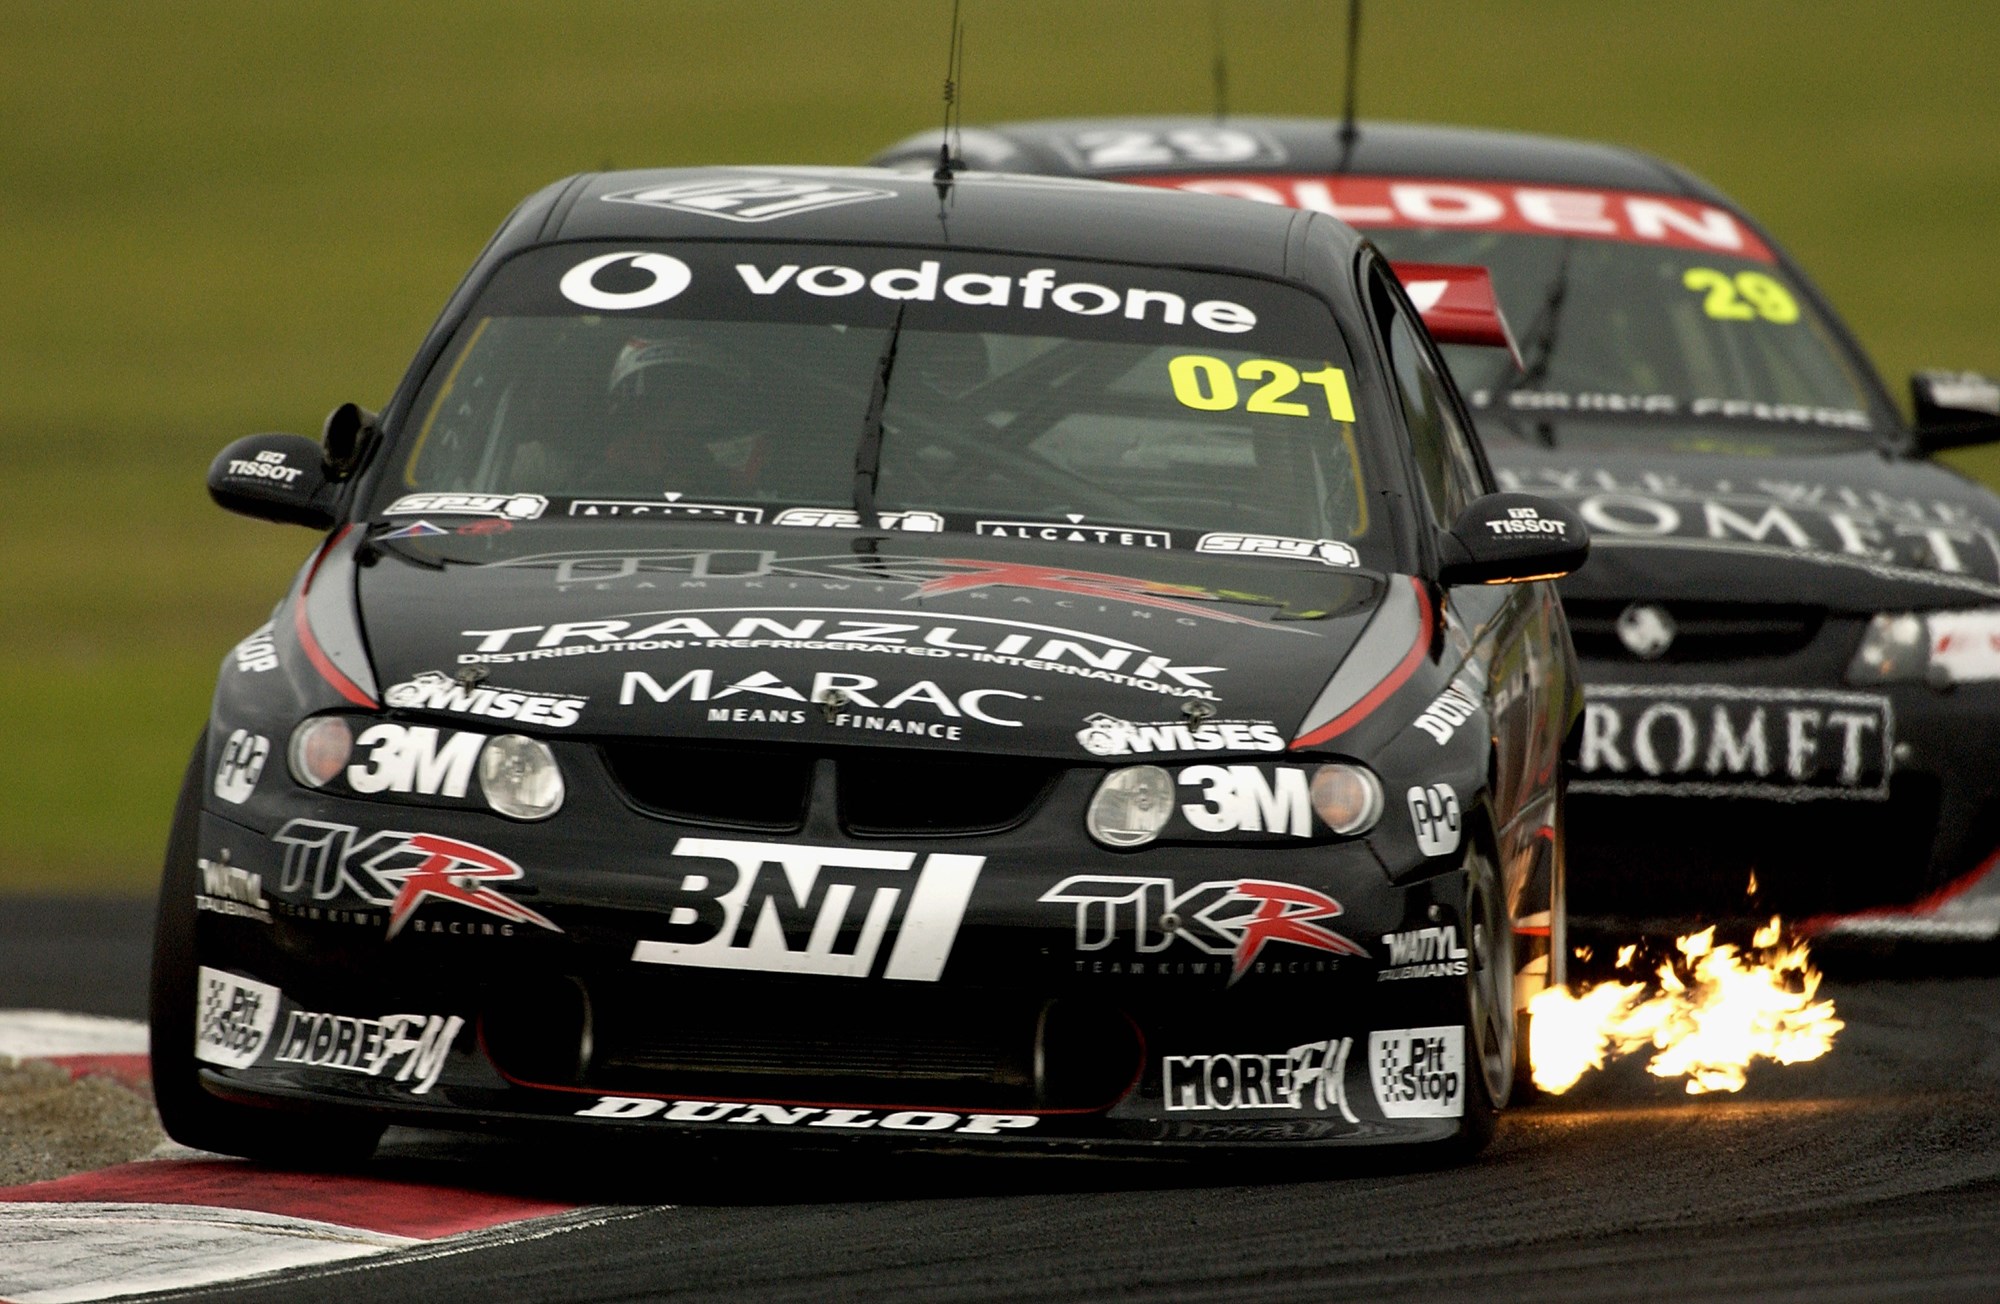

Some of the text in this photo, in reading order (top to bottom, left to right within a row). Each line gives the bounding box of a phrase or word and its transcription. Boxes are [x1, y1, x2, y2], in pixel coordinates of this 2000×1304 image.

[735, 261, 1258, 333] vodafone
[1683, 267, 1800, 325] 29
[1168, 355, 1357, 423] 021
[228, 459, 303, 483] TISSOT
[388, 494, 515, 516] SPY
[1485, 518, 1567, 535] TISSOT
[991, 526, 1160, 549] ALCATEL
[1201, 534, 1318, 558] SPY
[555, 581, 1197, 627] TEAM KIWI RACING
[456, 638, 1224, 701] DISTRIBUTION REFRIGERATED INTERNATIONAL
[461, 617, 1228, 688] TRANZLINK
[421, 680, 587, 728] WISES
[619, 669, 1028, 727] MARAC
[708, 708, 962, 741] MEANS FINANCE
[1128, 723, 1287, 753] WISES
[347, 723, 487, 798] 3M
[1178, 765, 1313, 838] 3M
[1406, 782, 1462, 857] PPG
[272, 818, 565, 942] TKR
[327, 911, 381, 926] KIWI
[414, 919, 515, 937] RACING
[638, 838, 916, 978] BNT
[1037, 875, 1373, 989] TKR
[1381, 925, 1469, 966] WATTYL
[1074, 959, 1145, 975] TEAM
[1158, 961, 1222, 975] KIWI
[230, 986, 264, 1028] Pit
[202, 1010, 263, 1058] Stop
[1409, 1037, 1446, 1073] Pit
[1400, 1064, 1458, 1107] Stop
[574, 1096, 1040, 1135] DUNLOP
